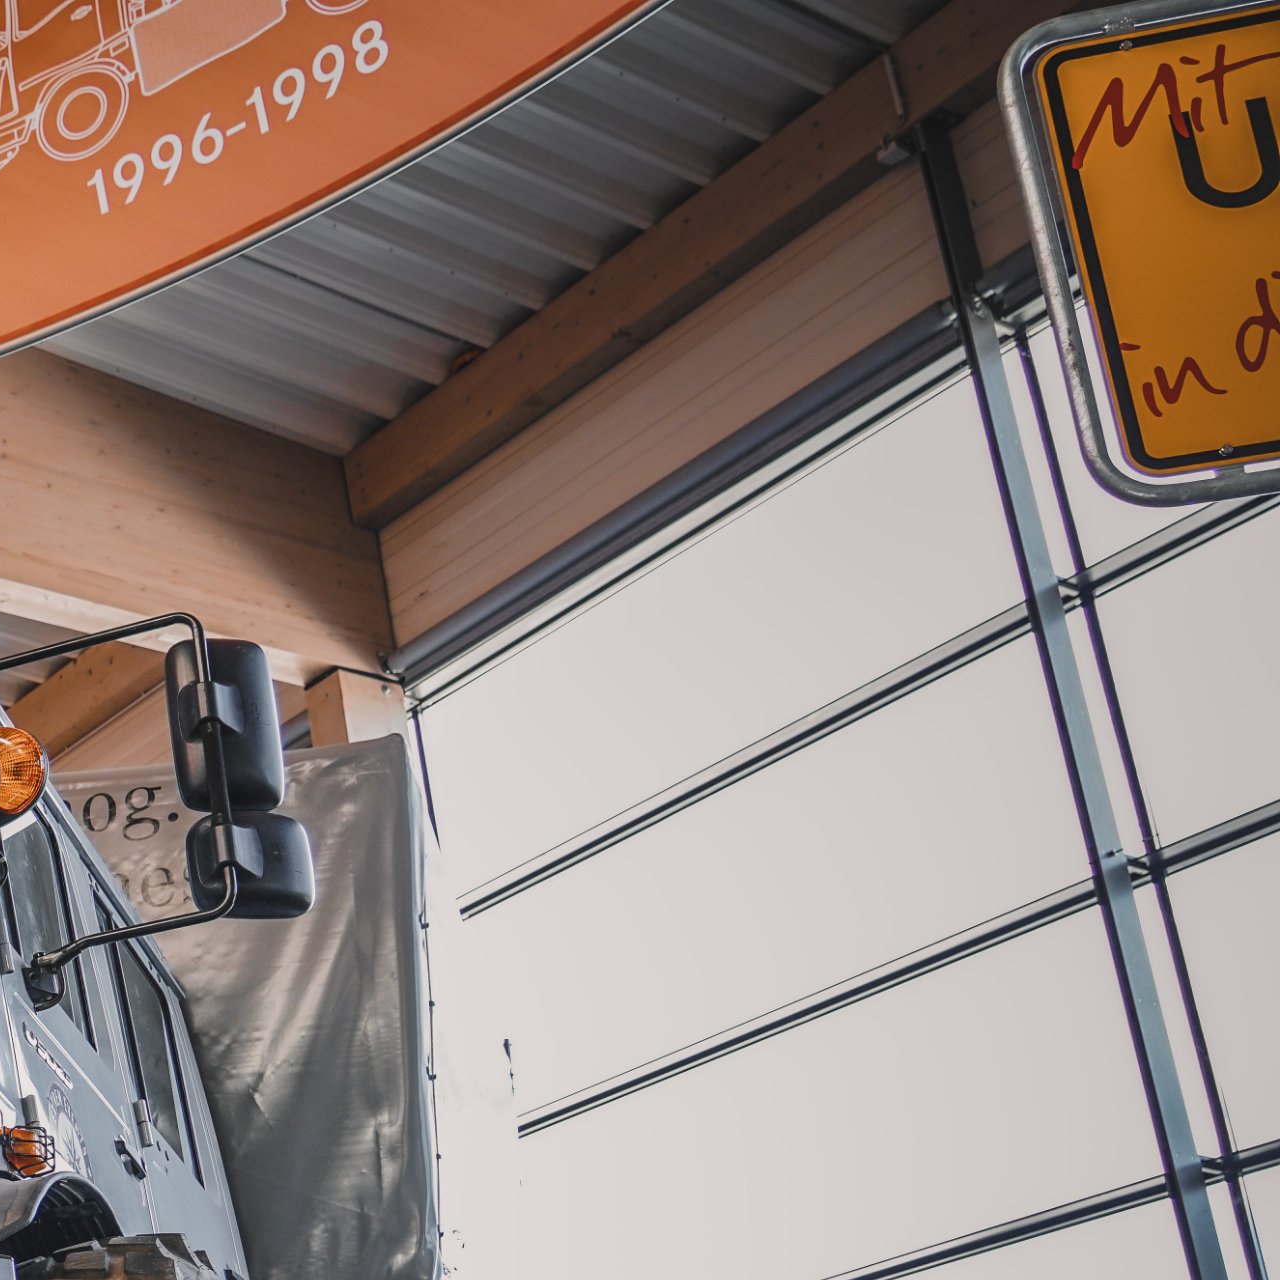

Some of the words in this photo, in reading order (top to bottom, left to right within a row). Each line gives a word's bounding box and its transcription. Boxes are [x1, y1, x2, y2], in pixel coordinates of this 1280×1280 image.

[86, 19, 389, 215] 1996-1998
[1072, 44, 1280, 170] Mit
[1120, 343, 1228, 418] in
[1235, 270, 1280, 373] d
[64, 785, 179, 842] og.
